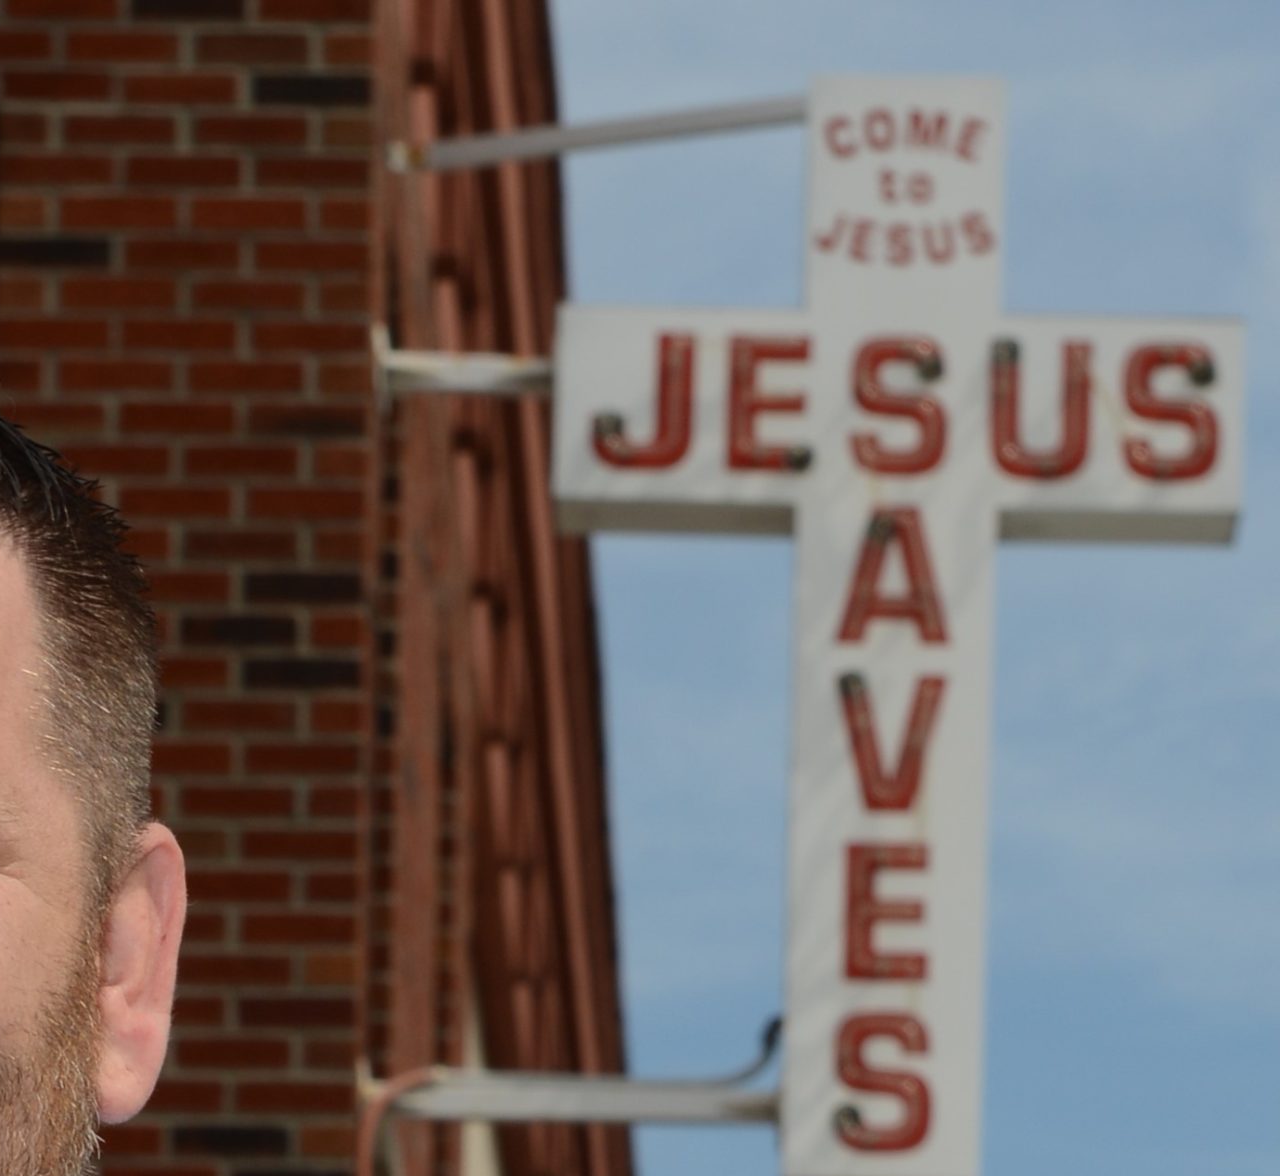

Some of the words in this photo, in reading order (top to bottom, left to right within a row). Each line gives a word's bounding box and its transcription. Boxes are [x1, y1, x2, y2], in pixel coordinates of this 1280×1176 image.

[824, 107, 987, 163] COME
[879, 165, 934, 206] to
[815, 211, 996, 267] JESUS
[591, 333, 1220, 481] JESUS
